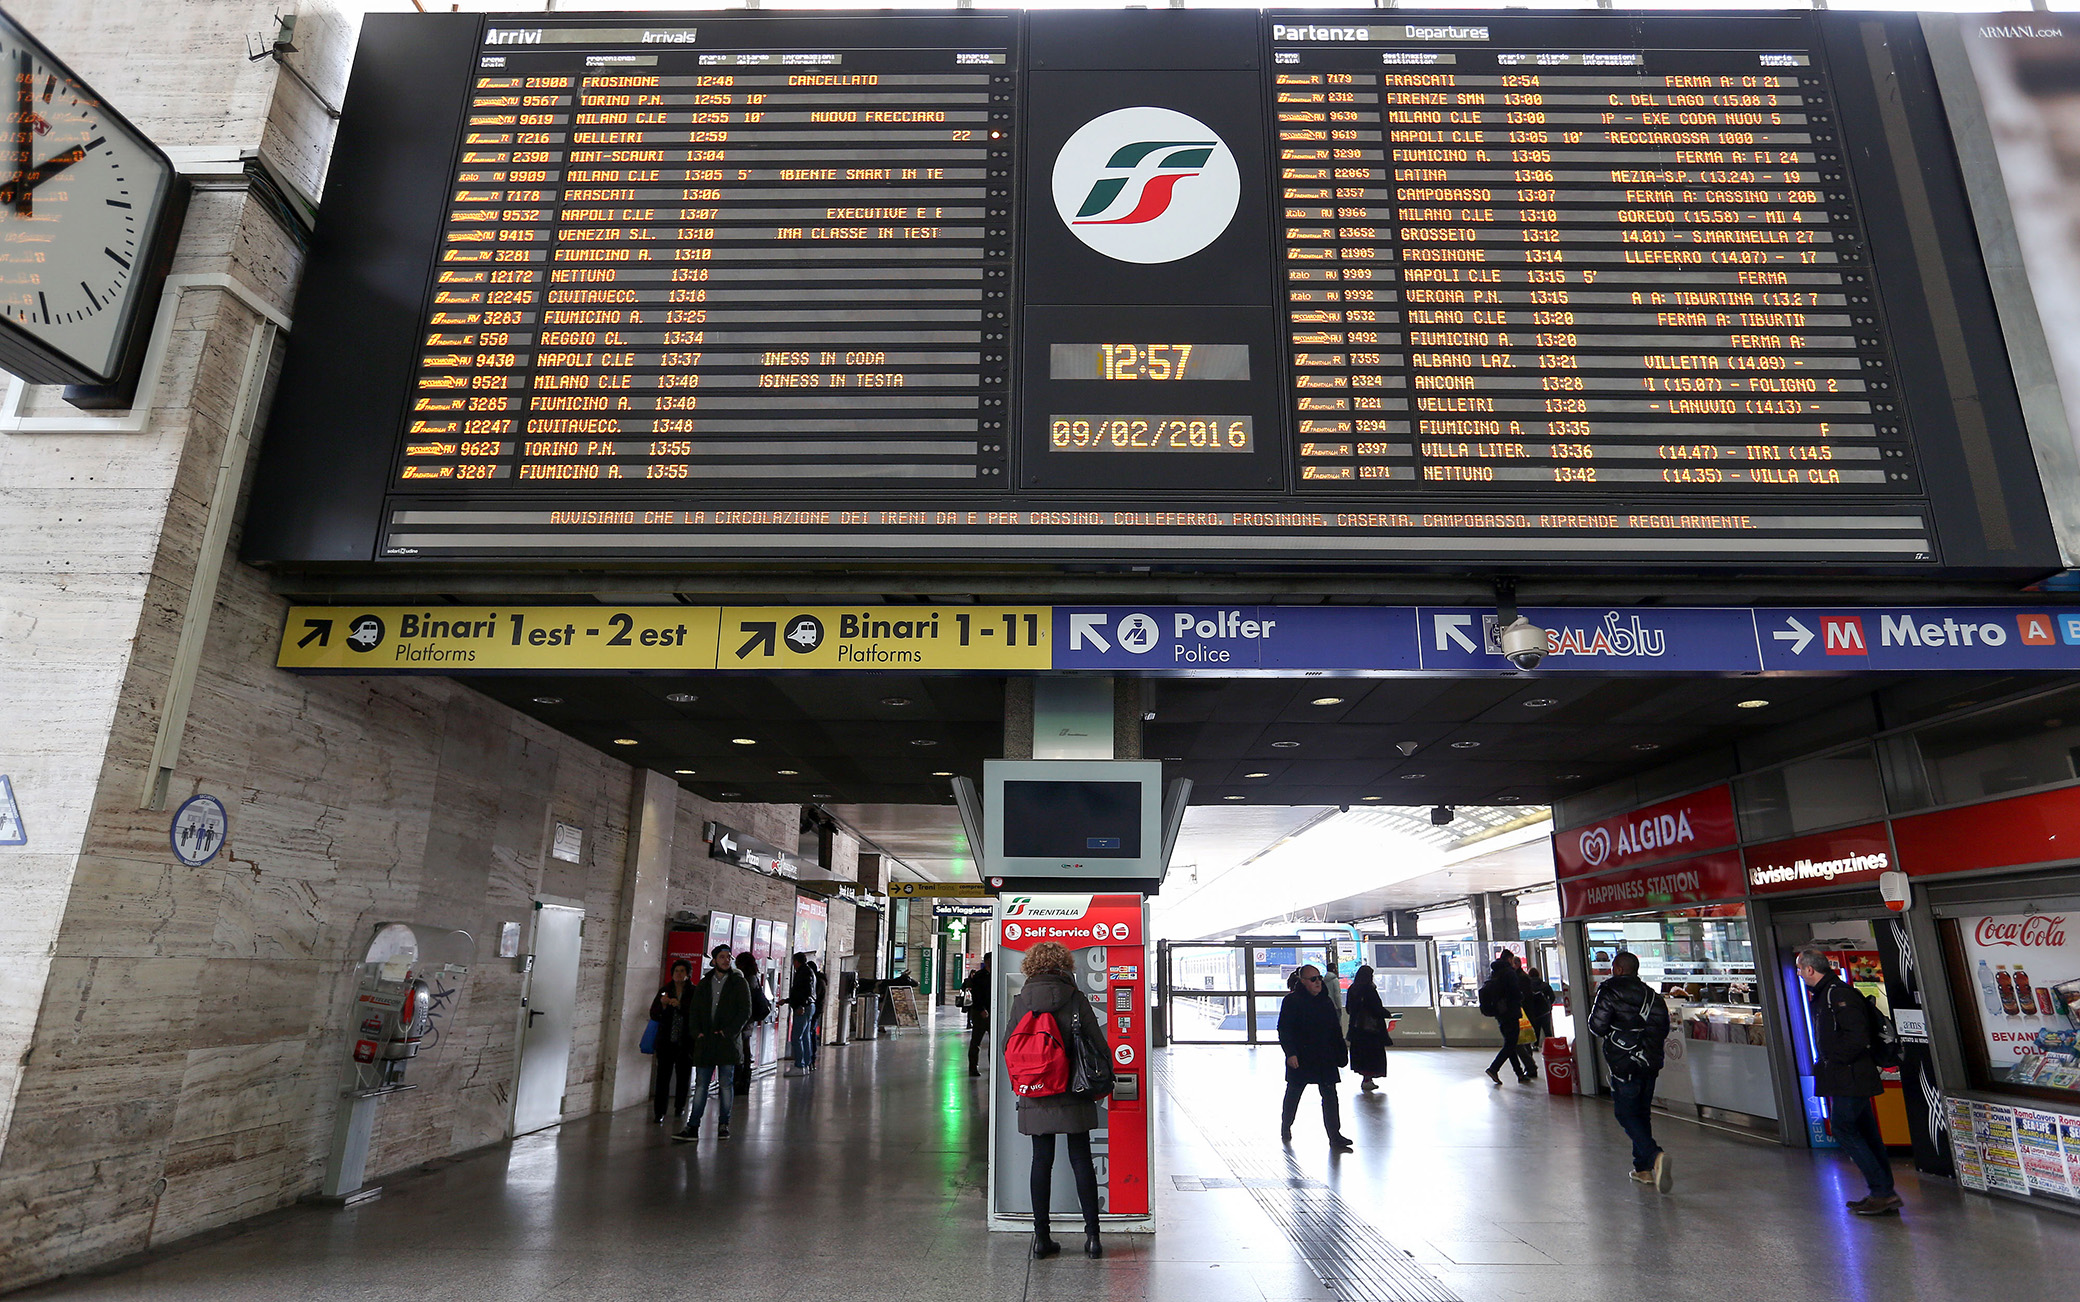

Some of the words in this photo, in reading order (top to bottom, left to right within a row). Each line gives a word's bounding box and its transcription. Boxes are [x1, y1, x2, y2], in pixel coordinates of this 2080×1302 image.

[484, 29, 543, 45] Arrivi
[641, 31, 696, 44] Arrivals
[1273, 25, 1370, 41] Partenze
[1405, 25, 1490, 40] Departures
[582, 77, 661, 87] FROSINONE
[696, 76, 734, 86] 12:48
[788, 76, 878, 86] CANCELLATO
[1385, 75, 1455, 86] FRASCATI
[581, 96, 631, 106] TORINO
[638, 95, 665, 105] P.N.
[695, 95, 732, 104] 12:55
[1387, 93, 1448, 104] FIRENZE
[1456, 94, 1485, 104] SMN
[576, 113, 628, 124] MILANO
[635, 113, 668, 123] C.LE
[691, 113, 730, 123] 12:55
[1389, 112, 1441, 123] MILANO
[1450, 112, 1482, 123] C.LE
[574, 132, 644, 143] VELLETRI
[689, 132, 728, 142] 12:59
[1391, 131, 1443, 142] NAPOLI
[1452, 131, 1484, 142] C.LE
[570, 151, 665, 162] MINT-SCAURI
[687, 151, 725, 161] 13:04
[1393, 150, 1467, 161] FIUMICINO
[1476, 150, 1490, 161] A.
[567, 171, 620, 181] MILANO
[628, 170, 660, 181] C.LE
[685, 170, 723, 180] 13:05
[1395, 169, 1447, 181] LATINA
[564, 190, 636, 200] FRASCATI
[683, 189, 721, 200] 13:06
[1397, 189, 1491, 201] CAMPOBASSO
[561, 210, 615, 220] NAPOLI
[622, 209, 655, 220] C.LE
[680, 209, 719, 220] 13:07
[558, 229, 621, 241] VENEZIA
[629, 229, 656, 239] S.L.
[678, 229, 715, 239] 13:10
[1401, 228, 1476, 241] GROSSETO
[555, 249, 630, 261] FIUMICINO
[639, 249, 653, 260] A.
[675, 249, 712, 260] 13:10
[1403, 249, 1485, 262] FROSINONE
[551, 269, 616, 282] NETTUNO
[672, 269, 709, 281] 13:18
[1404, 270, 1459, 282] NAPOLI
[1468, 270, 1501, 282] C.LE
[548, 290, 640, 303] CIVITAVECC.
[670, 290, 706, 302] 13:18
[1406, 290, 1464, 303] VERONA
[1473, 291, 1502, 303] P.N.
[544, 311, 621, 324] FIUMICINO
[630, 311, 644, 323] A.
[666, 311, 707, 323] 13:25
[1409, 311, 1464, 324] MILANO
[1473, 311, 1506, 324] C.LE
[541, 332, 596, 345] REGGIO
[605, 332, 628, 345] CL.
[664, 332, 704, 344] 13:34
[1411, 332, 1488, 346] FIUMICINO
[1498, 333, 1513, 346] A.
[537, 353, 594, 367] NAPOLI
[601, 354, 635, 366] C.LE
[662, 353, 702, 366] 13:37
[1101, 343, 1193, 381] 12:57
[1413, 354, 1472, 367] ALBANO
[1481, 354, 1516, 368] LAZ.
[534, 375, 590, 389] MILANO
[599, 375, 632, 389] C.LE
[658, 375, 699, 388] 13:40
[1415, 376, 1474, 389] ANCONA
[530, 397, 609, 410] FIUMICINO
[618, 397, 632, 409] A.
[655, 397, 697, 410] 13:40
[1418, 398, 1493, 412] VELLETRI
[527, 419, 621, 433] CIVITAVECC.
[653, 419, 693, 433] 13:48
[1051, 420, 1246, 447] 09/02/2016
[525, 442, 579, 456] TORINO
[588, 442, 616, 455] P.N.
[650, 442, 690, 455] 13:55
[1422, 443, 1469, 457] VILLA
[1477, 443, 1529, 457] LITER.
[520, 465, 600, 479] FIUMICINO
[609, 465, 623, 478] A.
[647, 465, 689, 478] 13:55
[1424, 466, 1493, 481] NETTUNO
[550, 511, 634, 525] AVVISIAMO
[643, 511, 675, 525] CHE
[684, 511, 704, 525] LA
[714, 511, 830, 525] CIRCOLAZIONE
[841, 511, 869, 525] DEI
[879, 511, 927, 525] TRENI
[936, 511, 958, 525] DA
[967, 512, 977, 525] E
[988, 512, 1018, 525] PER
[1029, 512, 1104, 526] CASSINO,
[1114, 512, 1224, 526] COLLEFERRO,
[1233, 513, 1328, 527] FROSINONE,
[1337, 513, 1415, 527] CASERTA,
[1423, 513, 1532, 528] CAMPOBASSO,
[1539, 514, 1619, 528] RIPRENDE
[1629, 514, 1758, 529] REGOLARMENTE.
[400, 612, 497, 639] Binari
[839, 612, 939, 639] Binari
[1175, 611, 1276, 640] Polfer
[1826, 619, 1866, 650] M
[1881, 614, 2008, 649] Metro
[2028, 620, 2048, 639] A
[395, 643, 476, 663] Platforms
[837, 644, 922, 664] Platforms
[1175, 644, 1231, 664] Police
[1617, 809, 1695, 857] ALGIDA
[1749, 851, 1888, 886] Riviste/Magazines
[1587, 879, 1645, 905] HAPPINESS
[1647, 870, 1700, 895] STATION
[1028, 908, 1079, 917] TRENITALIA
[1024, 926, 1047, 938] Self
[1048, 926, 1090, 938] Service
[1975, 916, 2067, 948] Coca-Cola
[1809, 1108, 1825, 1143] RENT
